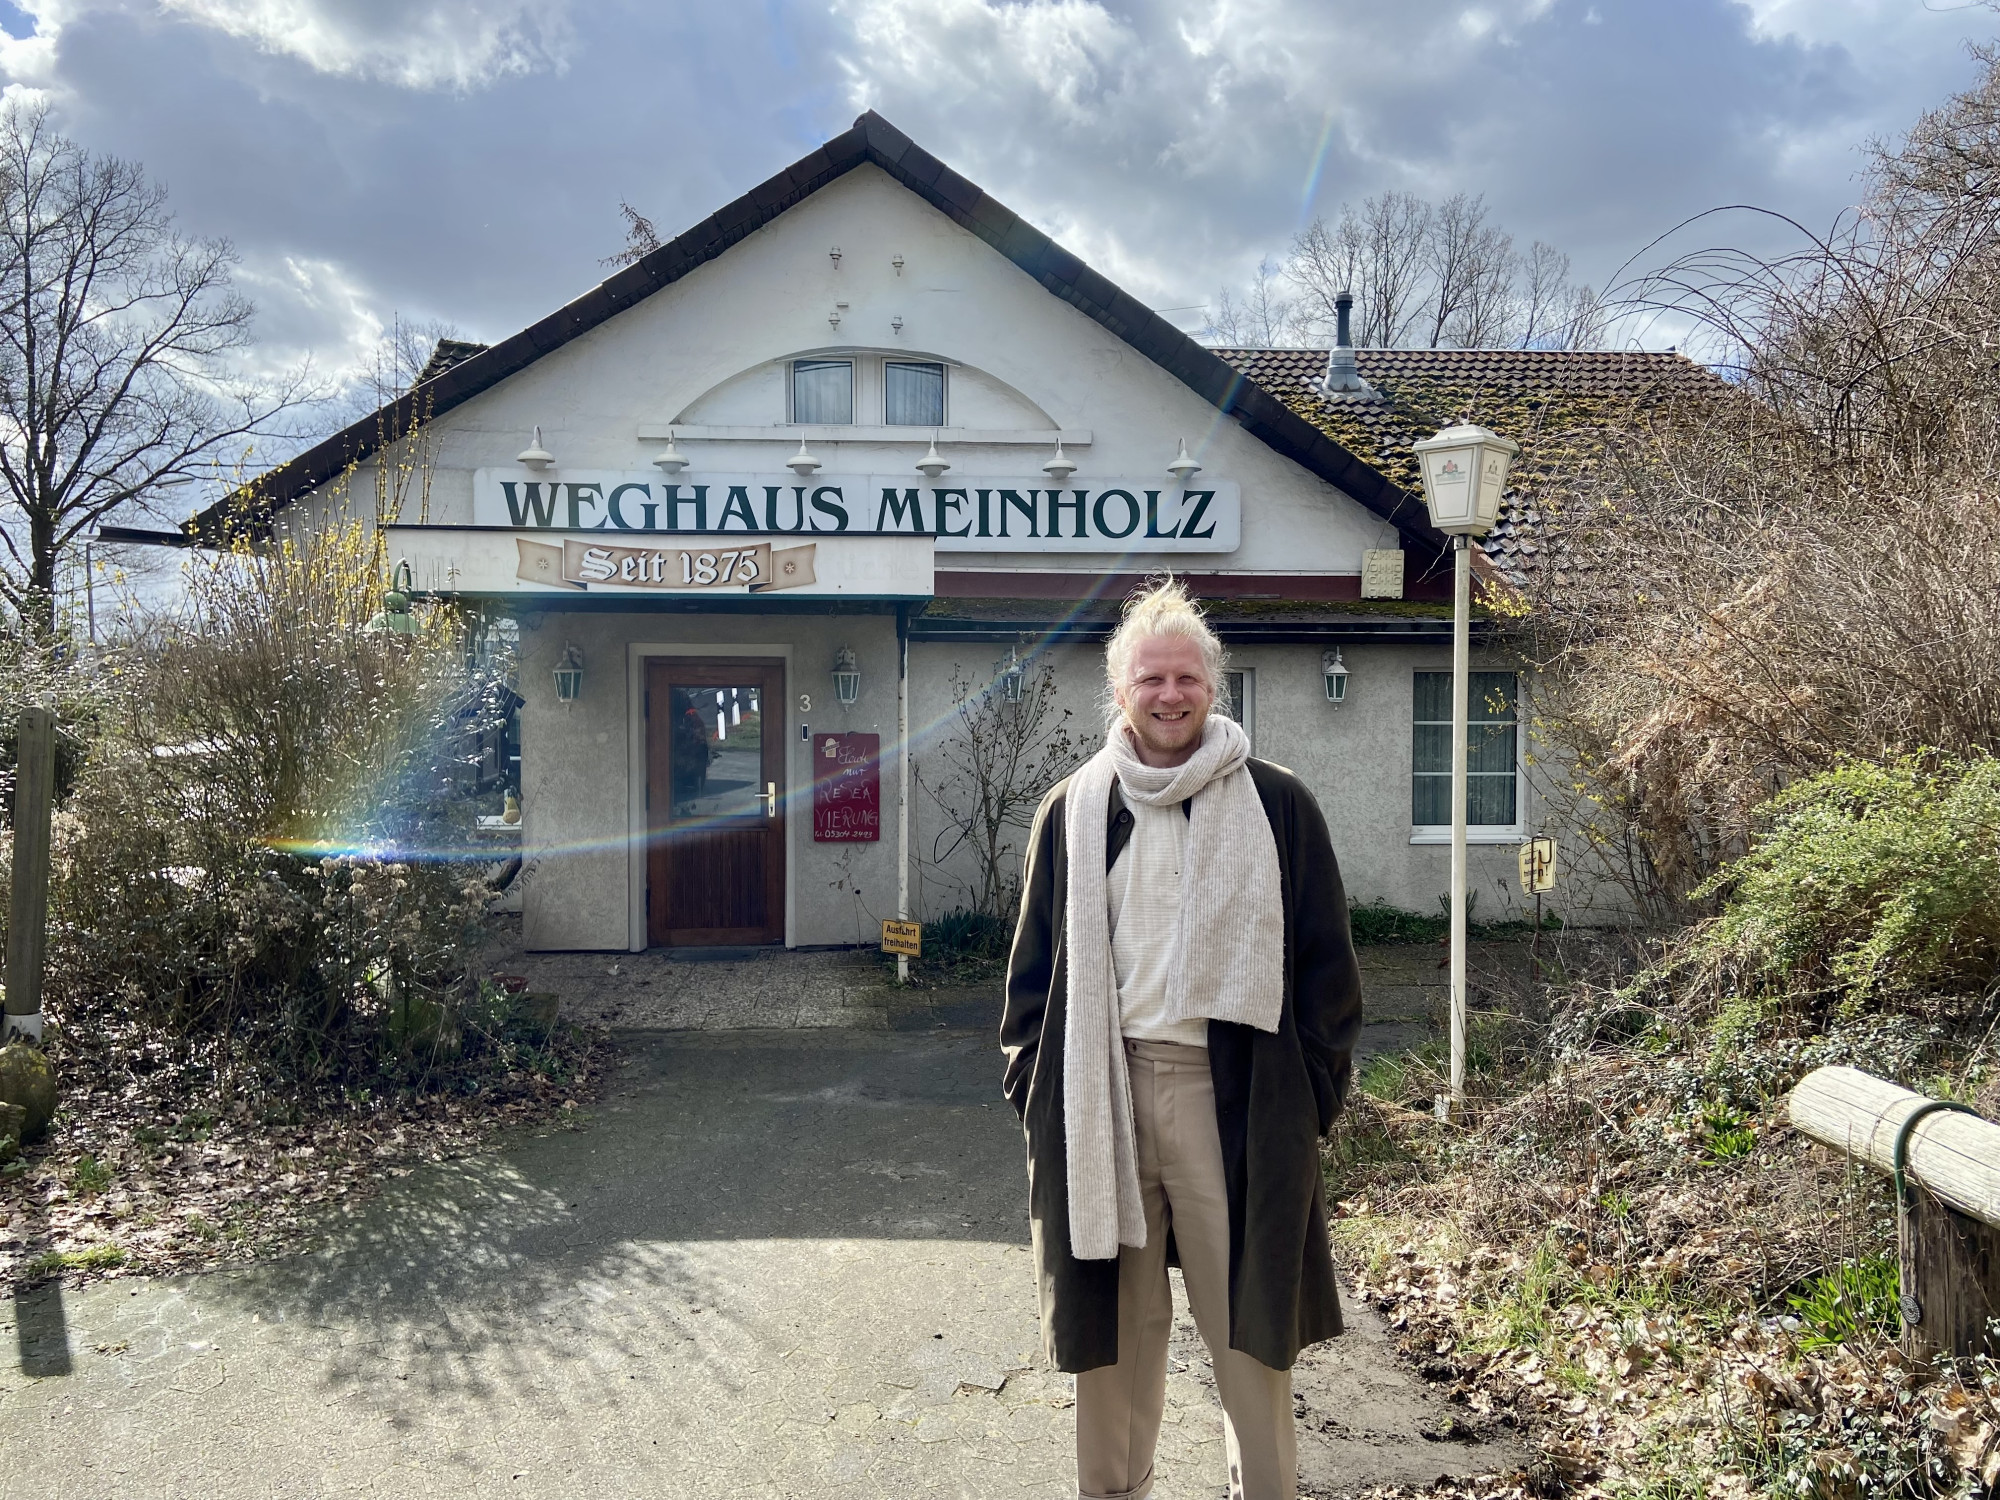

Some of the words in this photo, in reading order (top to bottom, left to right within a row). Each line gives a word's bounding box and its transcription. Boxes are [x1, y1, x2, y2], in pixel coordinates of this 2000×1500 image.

[500, 481, 849, 531] WEGHAUS
[876, 487, 1217, 539] MEINHOLZ
[578, 547, 667, 582] Seit
[678, 549, 760, 585] 1875
[800, 694, 812, 712] 3
[815, 806, 878, 829] VIERUNG
[884, 936, 919, 950] freihalten
